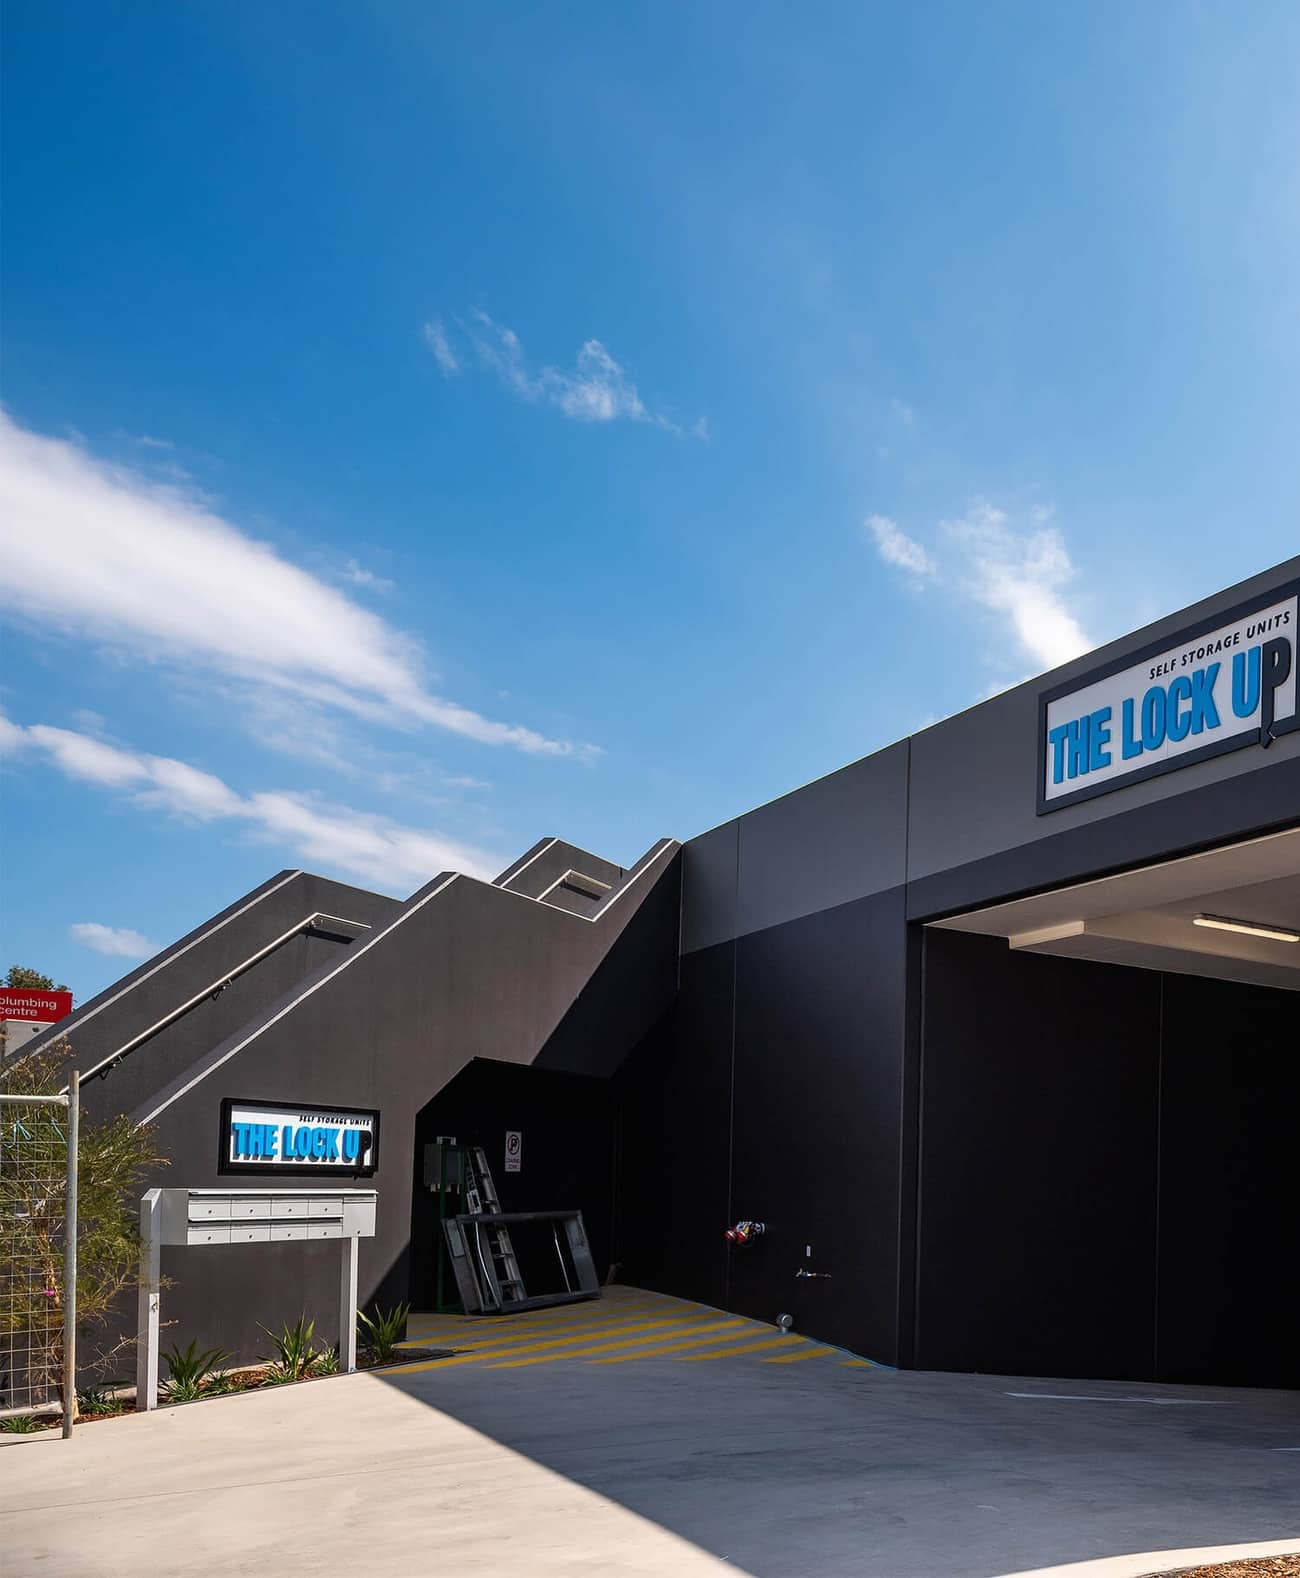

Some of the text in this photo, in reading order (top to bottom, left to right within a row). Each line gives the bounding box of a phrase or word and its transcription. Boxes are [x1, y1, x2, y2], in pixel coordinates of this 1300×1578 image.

[1149, 610, 1291, 680] SELF STORAGE UNITS
[1049, 636, 1292, 785] THE LOCK UP
[232, 1122, 372, 1179] THE LOCK UP
[299, 1115, 370, 1127] SELF STORAGE UNITS
